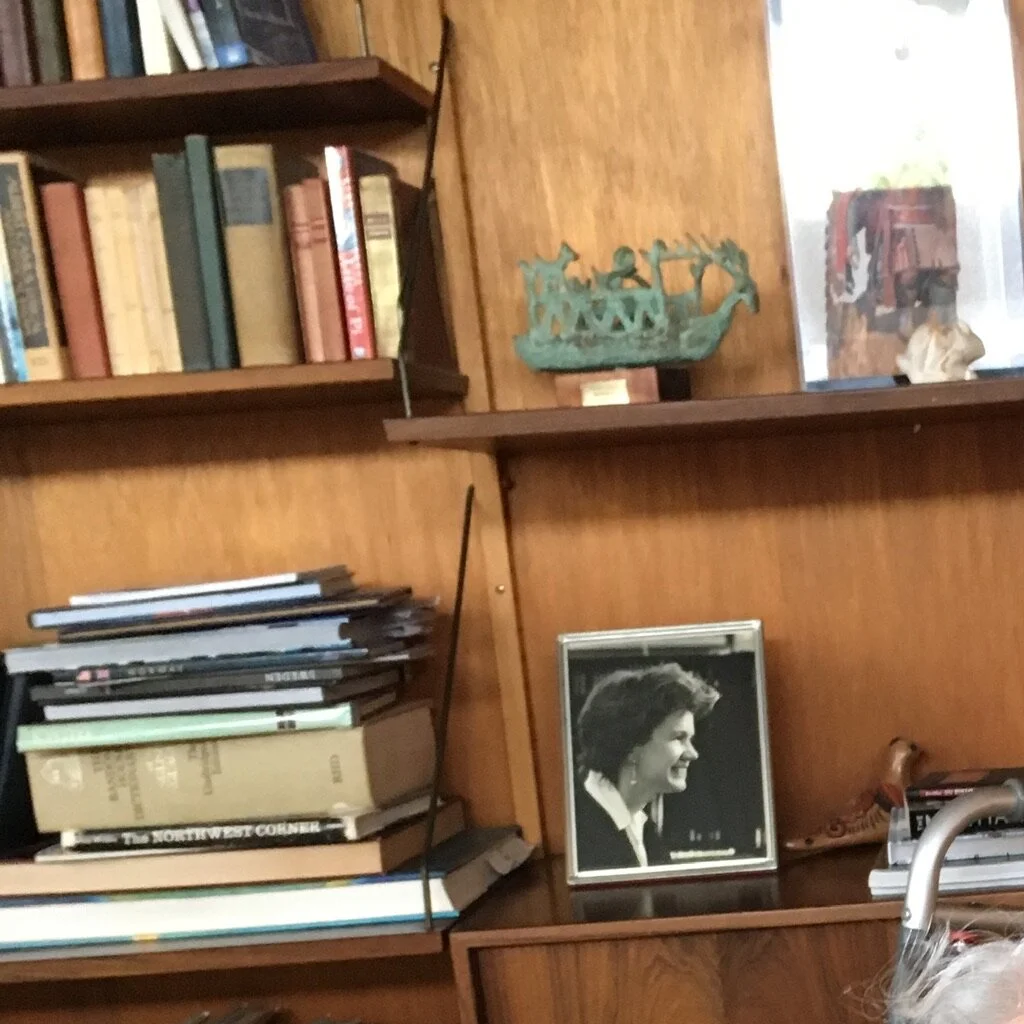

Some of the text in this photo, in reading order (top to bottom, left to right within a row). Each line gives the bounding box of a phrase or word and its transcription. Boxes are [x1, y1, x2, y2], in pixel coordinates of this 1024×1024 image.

[121, 831, 150, 845] The
[152, 825, 255, 843] NORTHWEST
[255, 821, 321, 837] CORNER
